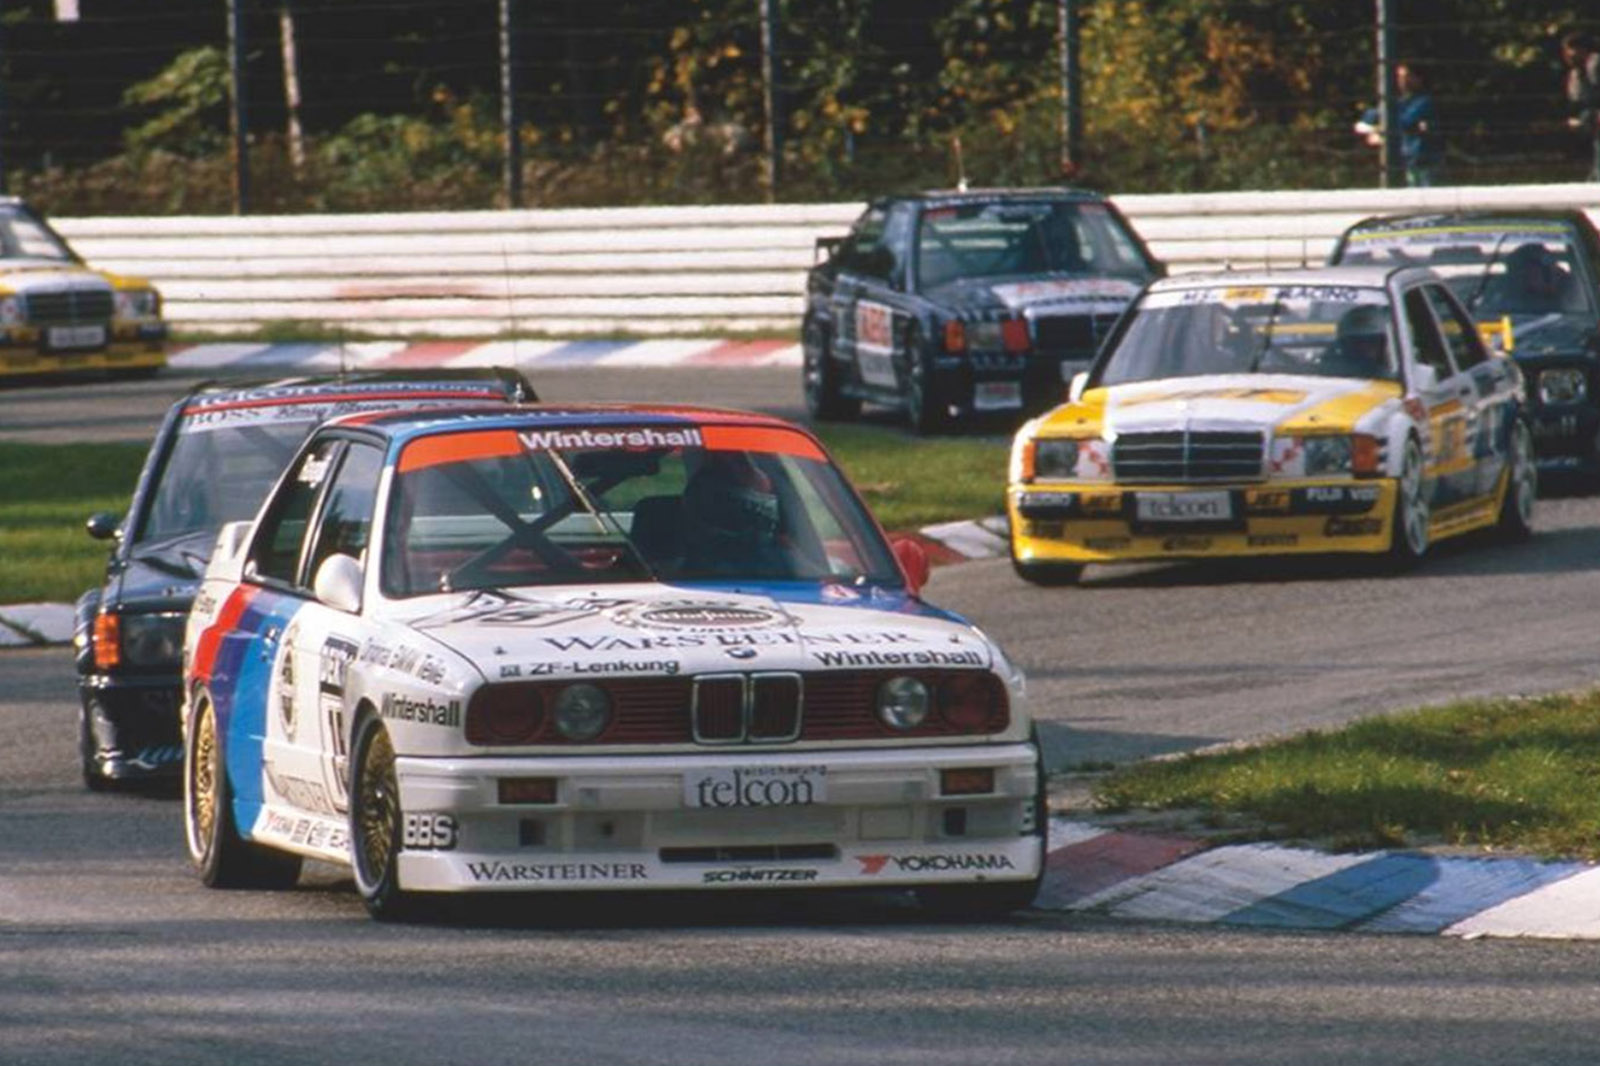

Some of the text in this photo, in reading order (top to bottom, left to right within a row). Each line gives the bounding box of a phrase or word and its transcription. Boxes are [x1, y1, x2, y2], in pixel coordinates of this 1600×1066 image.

[517, 426, 703, 450] Wintershall
[541, 631, 924, 651] WARSTEINER
[814, 649, 984, 666] Wintershall
[529, 660, 680, 676] ZF-Lenkung
[381, 691, 461, 728] Wintershall
[697, 767, 814, 808] telcon
[403, 813, 454, 848] BBS
[466, 861, 649, 881] WARSTEINER
[891, 854, 1015, 871] YOKOHAMA
[703, 868, 818, 883] SCHNITZER
